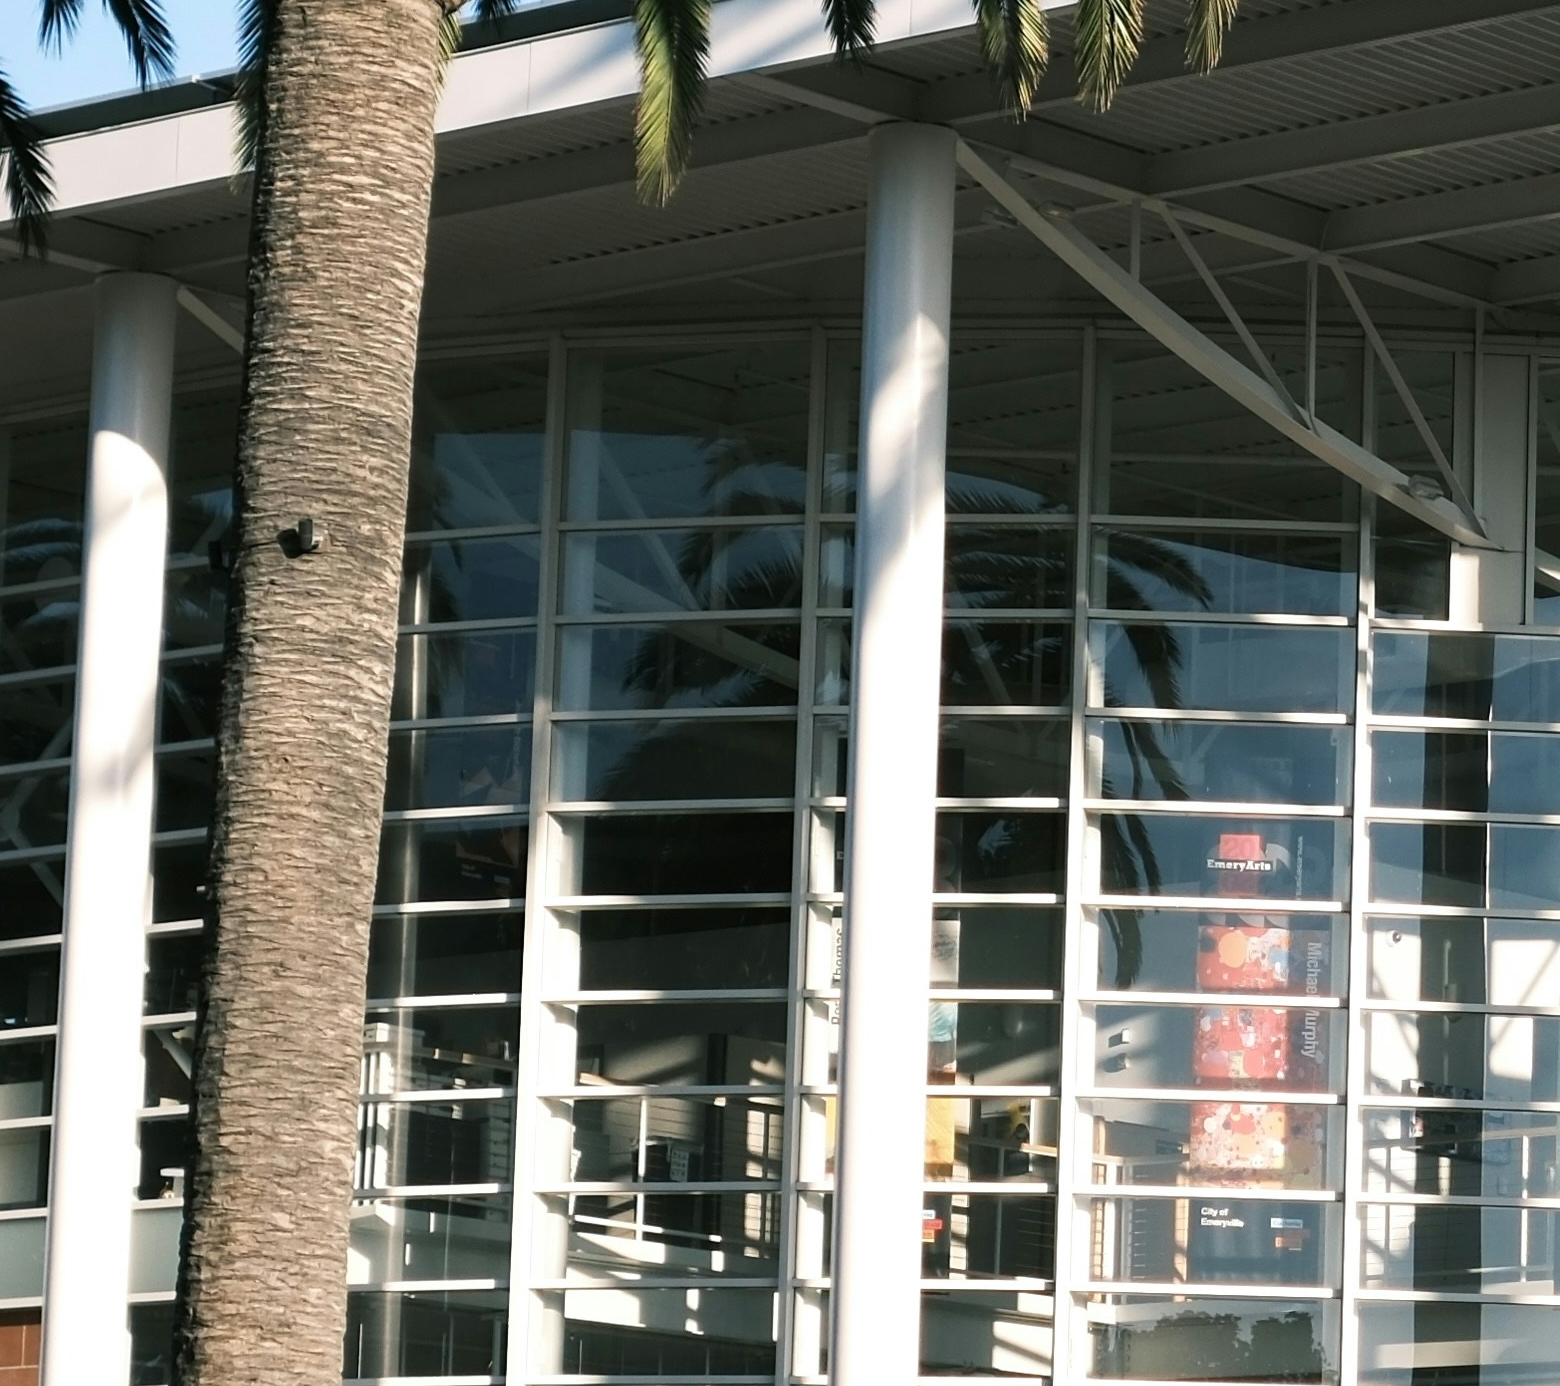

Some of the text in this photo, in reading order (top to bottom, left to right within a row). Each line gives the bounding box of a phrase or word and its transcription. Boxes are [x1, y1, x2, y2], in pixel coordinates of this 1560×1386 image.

[1207, 859, 1271, 872] EmeryArts
[1201, 1207, 1228, 1217] City of
[1201, 1218, 1245, 1228] Emeryville
